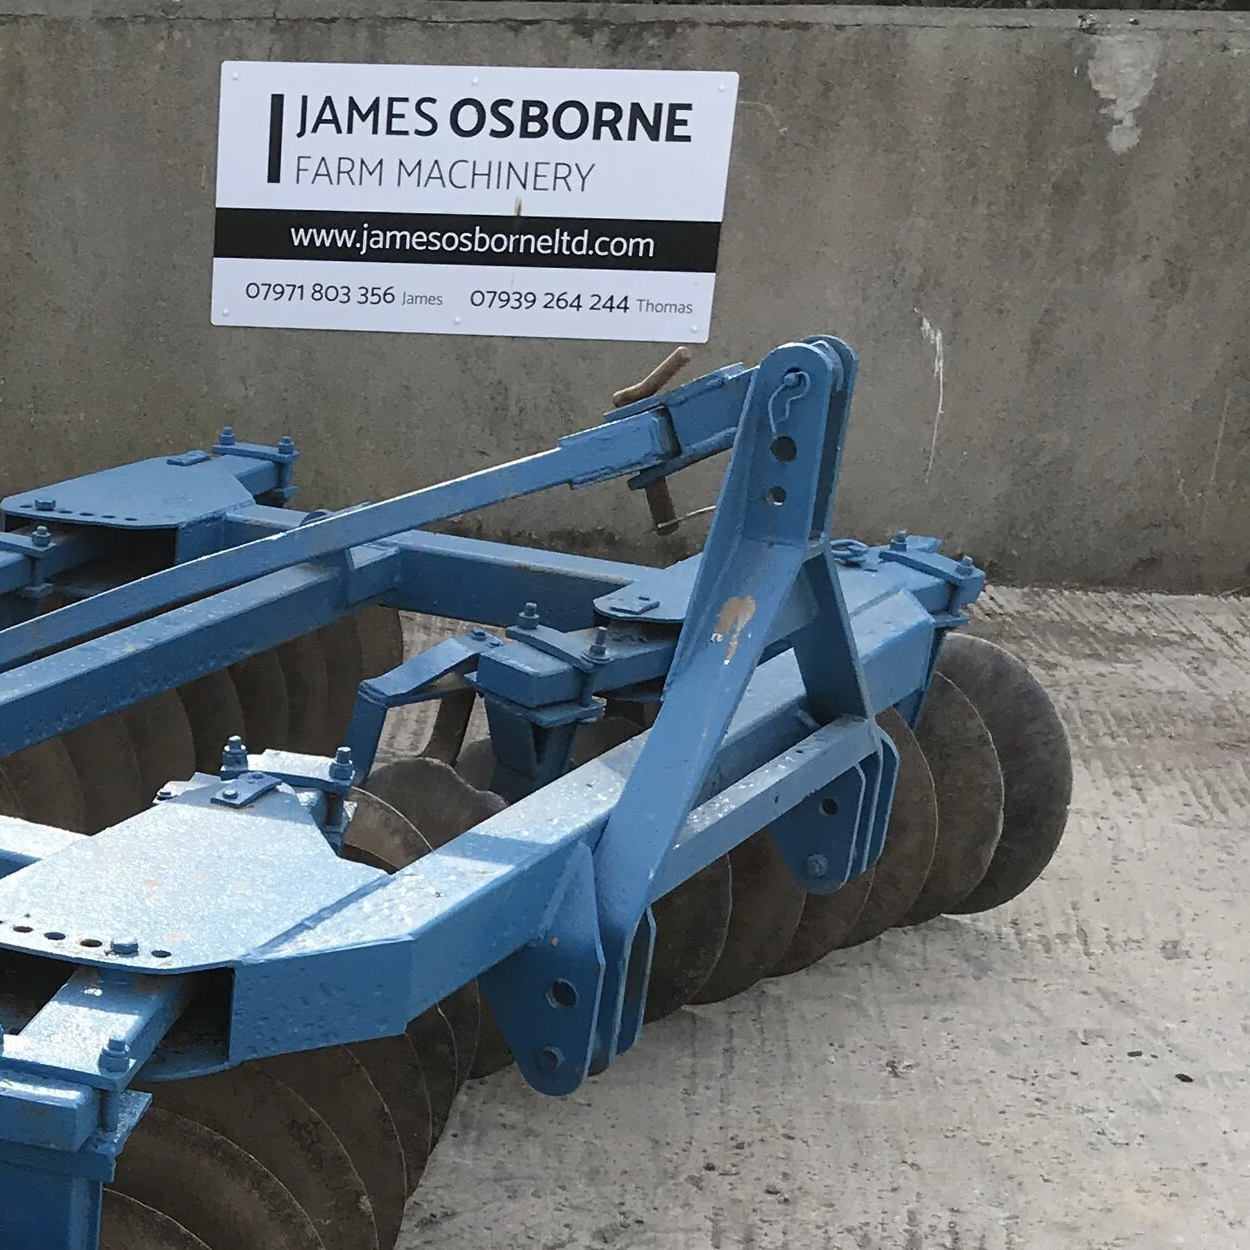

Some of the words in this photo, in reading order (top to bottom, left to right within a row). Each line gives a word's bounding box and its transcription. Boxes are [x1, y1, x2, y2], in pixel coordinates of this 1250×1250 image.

[295, 94, 439, 139] JAMES
[449, 97, 694, 143] OSBORNE
[295, 155, 384, 187] FARM
[396, 158, 596, 193] MACHINERY
[290, 222, 655, 258] www.jamesosborneltd.com
[245, 282, 305, 302] 07971
[310, 283, 352, 305] 803
[356, 285, 396, 306] 356
[401, 291, 444, 307] James
[469, 289, 537, 311] 07939
[542, 291, 583, 313] 264
[588, 293, 631, 314] 244
[636, 298, 693, 315] Thomas
